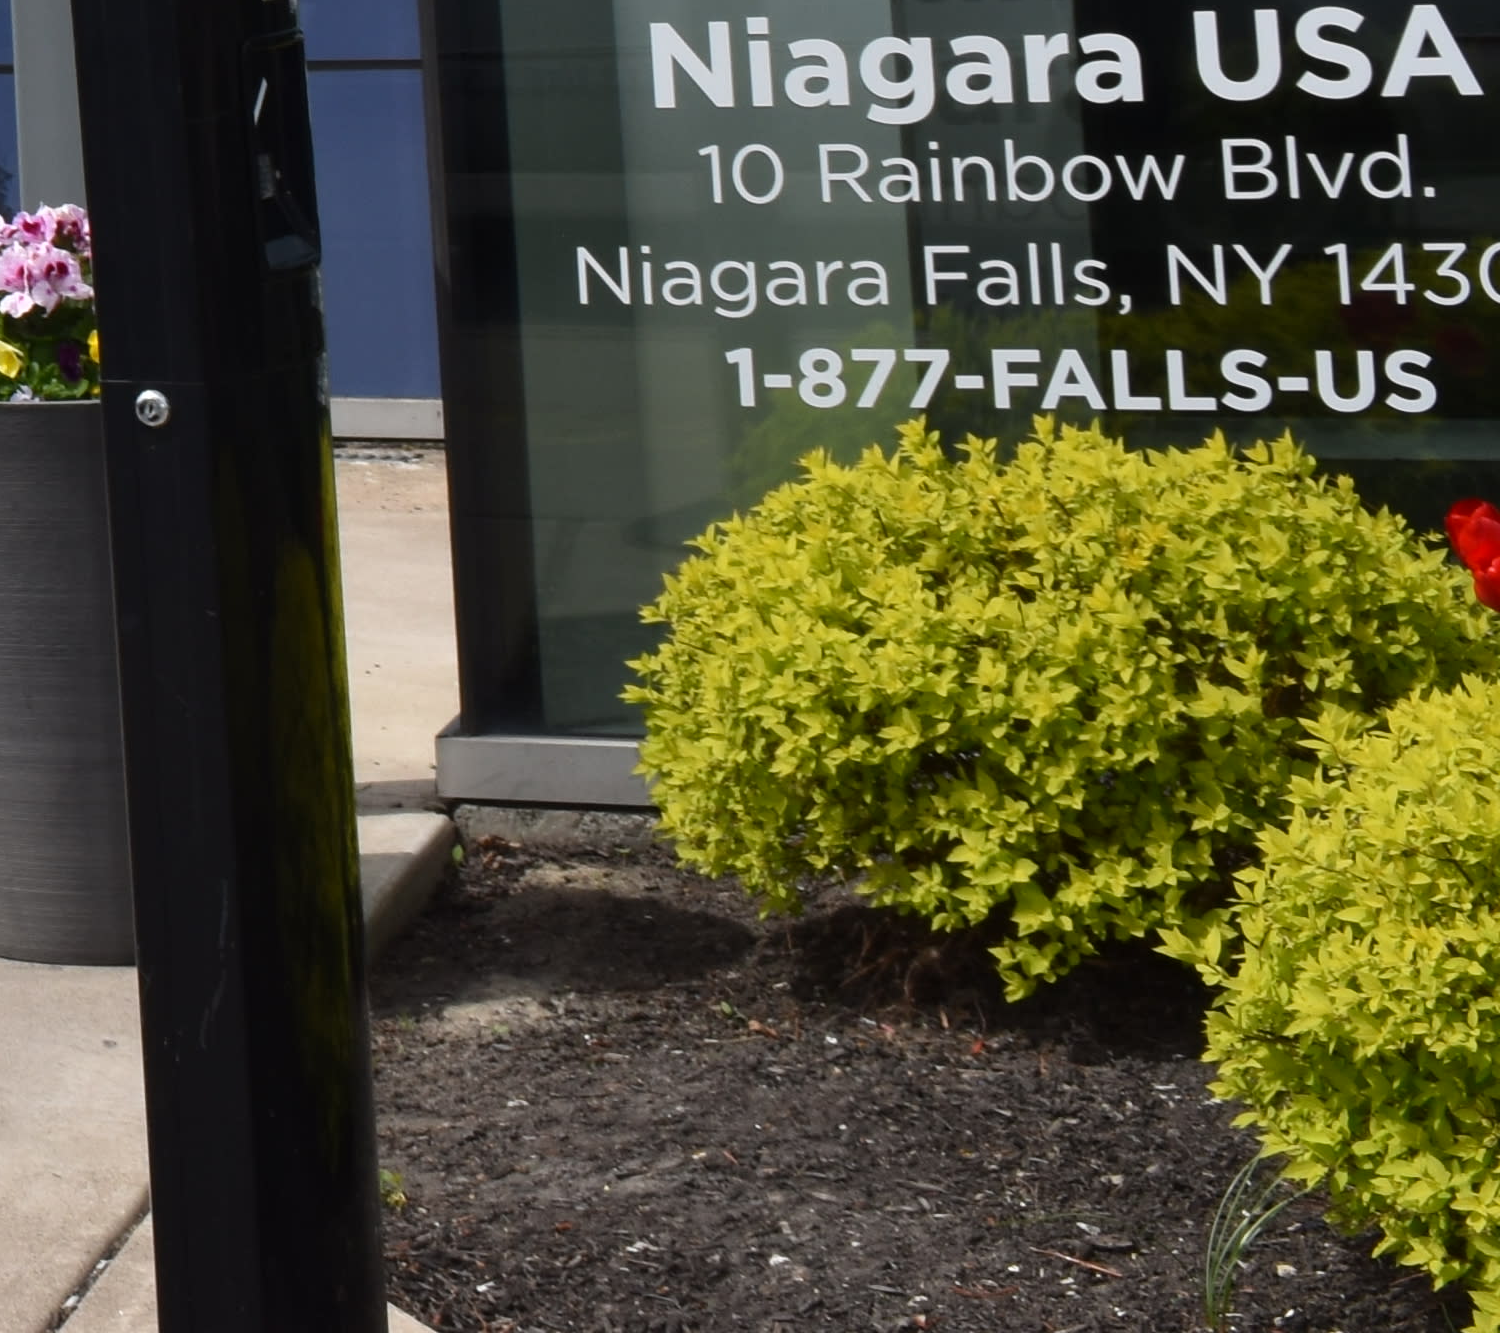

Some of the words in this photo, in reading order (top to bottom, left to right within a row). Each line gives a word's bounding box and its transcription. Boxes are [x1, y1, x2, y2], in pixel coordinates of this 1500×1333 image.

[648, 17, 1145, 126] Niagara
[1192, 3, 1484, 104] USA
[697, 142, 783, 205] 10
[818, 138, 1186, 203] Rainbow
[1220, 133, 1436, 201] Blvd.
[576, 244, 889, 318] Niagara
[922, 241, 1134, 317] Falls,
[1167, 241, 1296, 307] NY
[724, 346, 1438, 413] 1-877-FALLS-US
